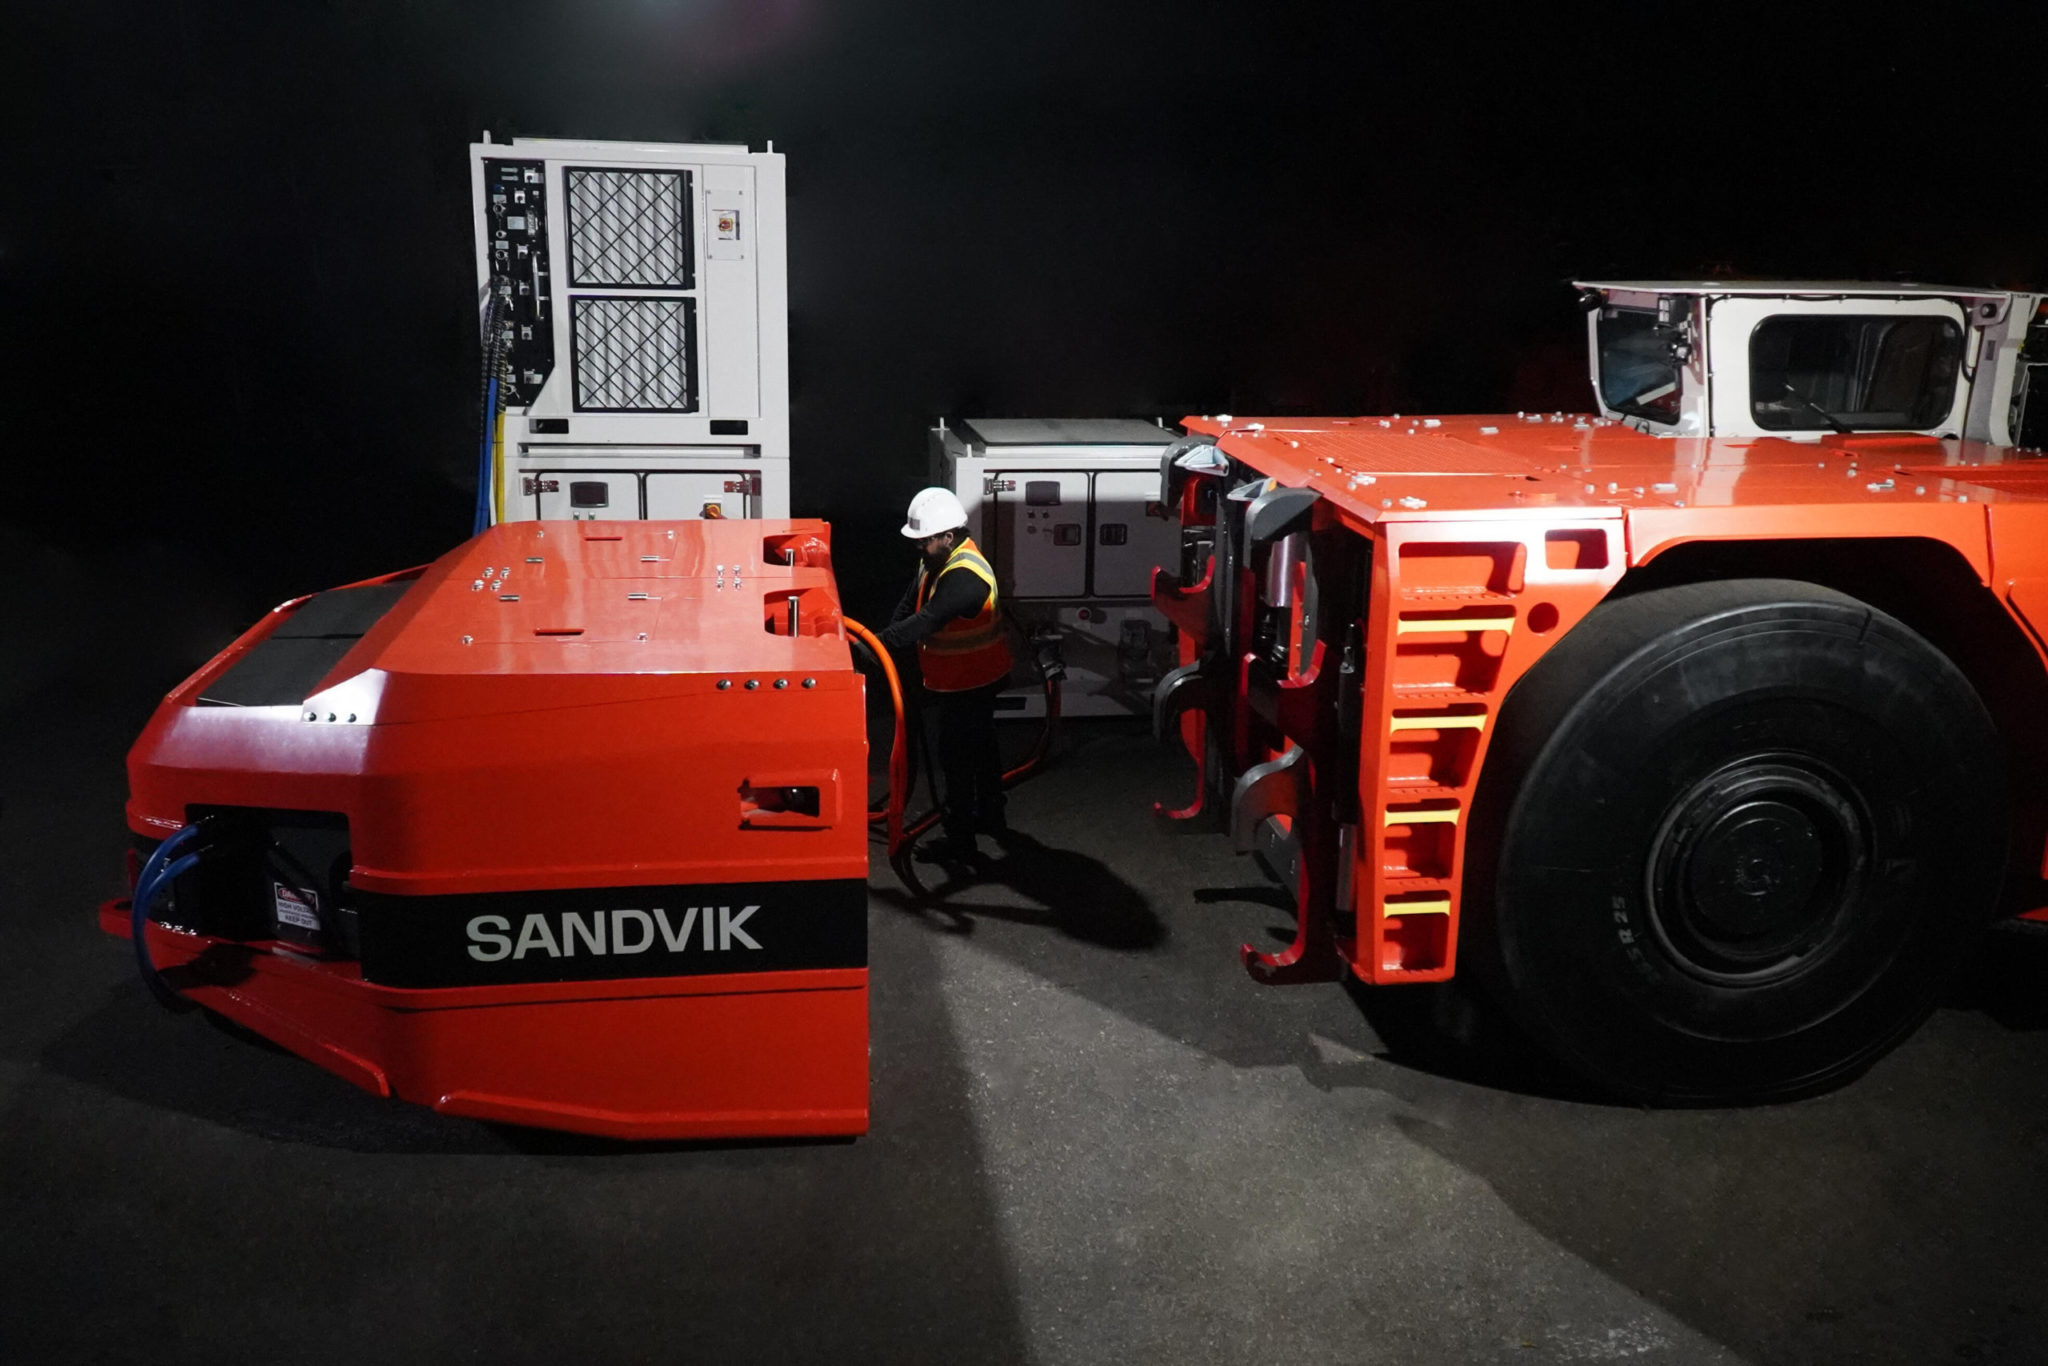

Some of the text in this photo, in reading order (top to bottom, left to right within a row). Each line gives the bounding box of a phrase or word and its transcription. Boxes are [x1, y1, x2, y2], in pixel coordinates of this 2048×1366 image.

[285, 914, 300, 923] KEEP
[301, 918, 313, 926] OUT
[466, 905, 763, 962] SANDVIK
